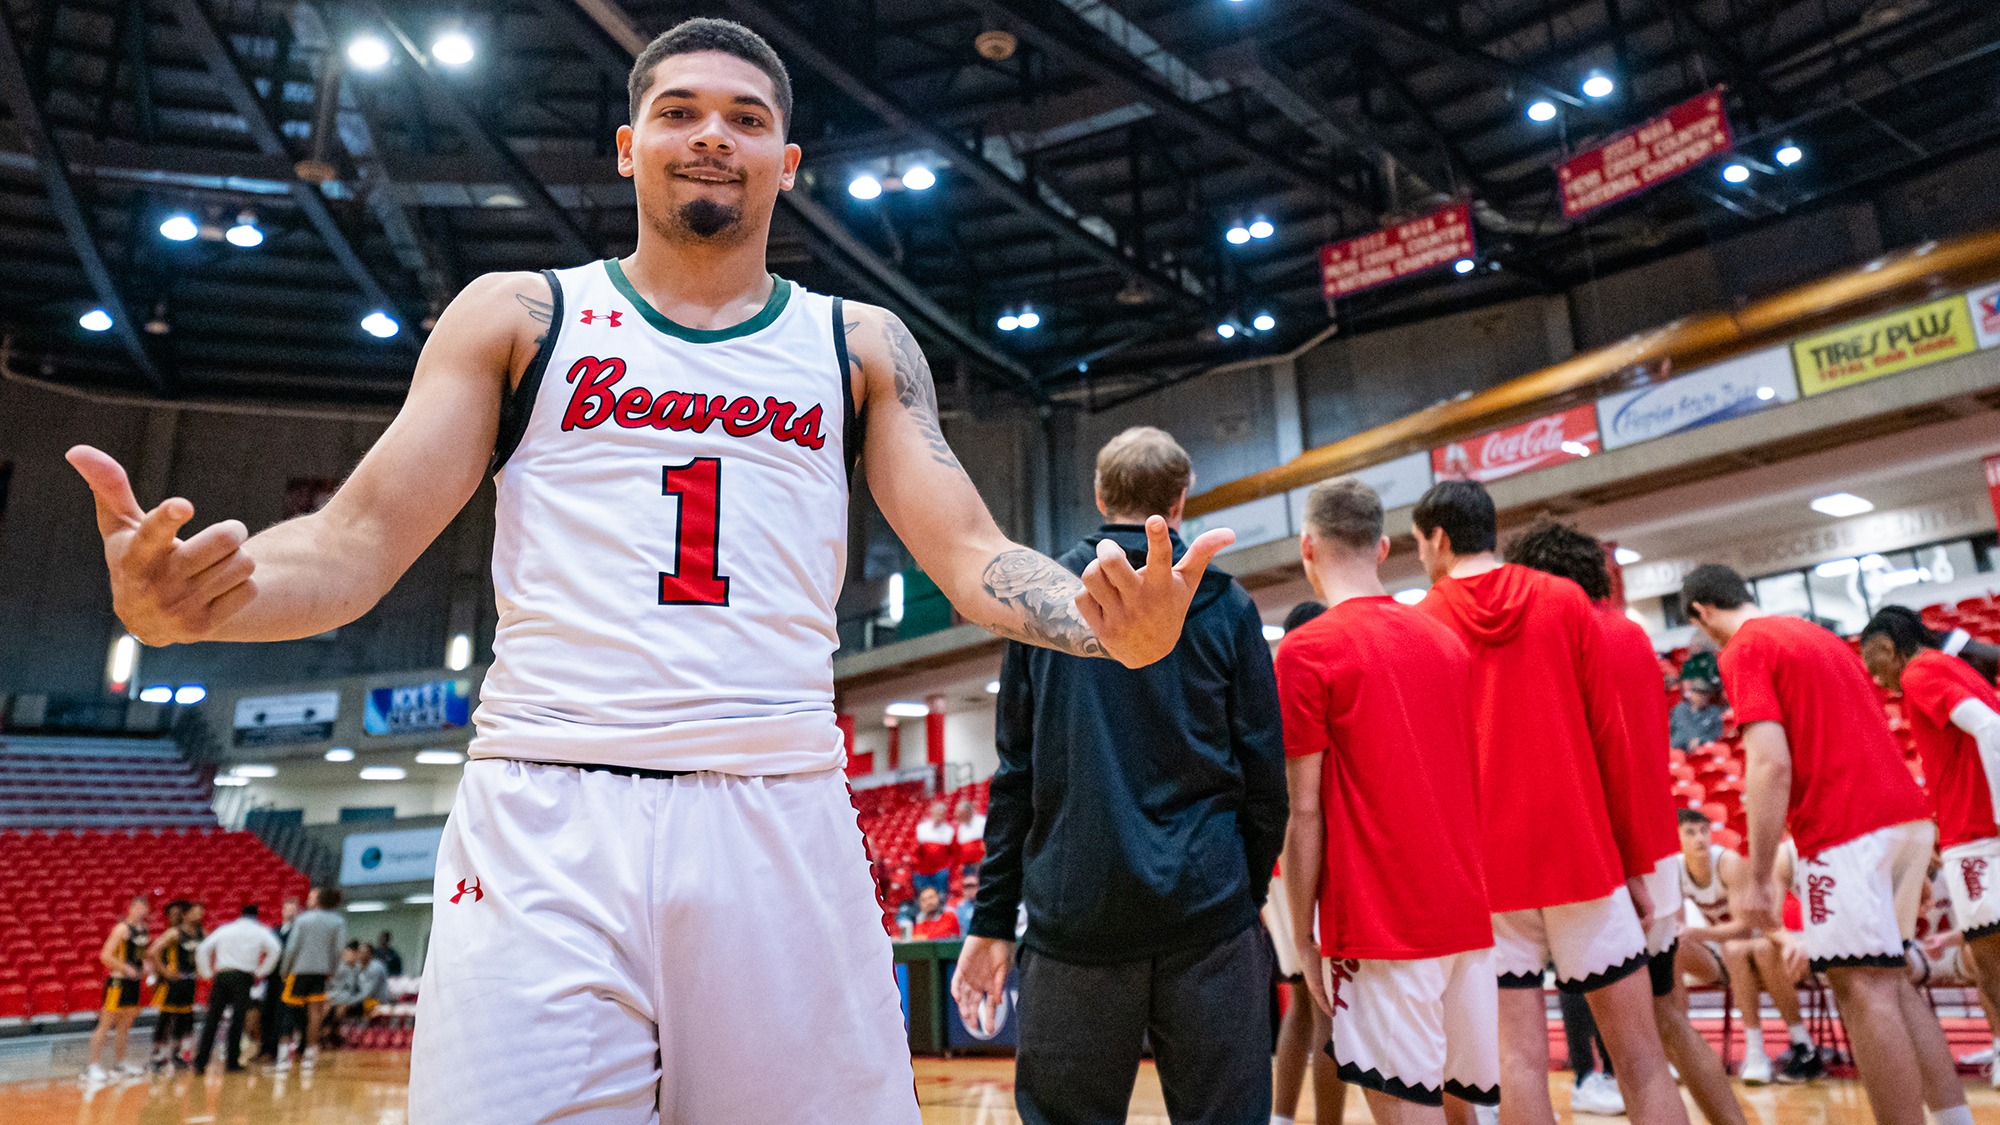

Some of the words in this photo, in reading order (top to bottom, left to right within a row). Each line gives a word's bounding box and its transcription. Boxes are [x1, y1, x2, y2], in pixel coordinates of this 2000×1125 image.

[1809, 329, 1880, 369] TIRES
[1885, 308, 1952, 349] PLUS
[1818, 360, 1866, 381] TOTAL
[561, 355, 826, 451] Beavers
[658, 457, 730, 607] 1
[1807, 874, 1836, 925] State
[1961, 858, 1988, 901] State
